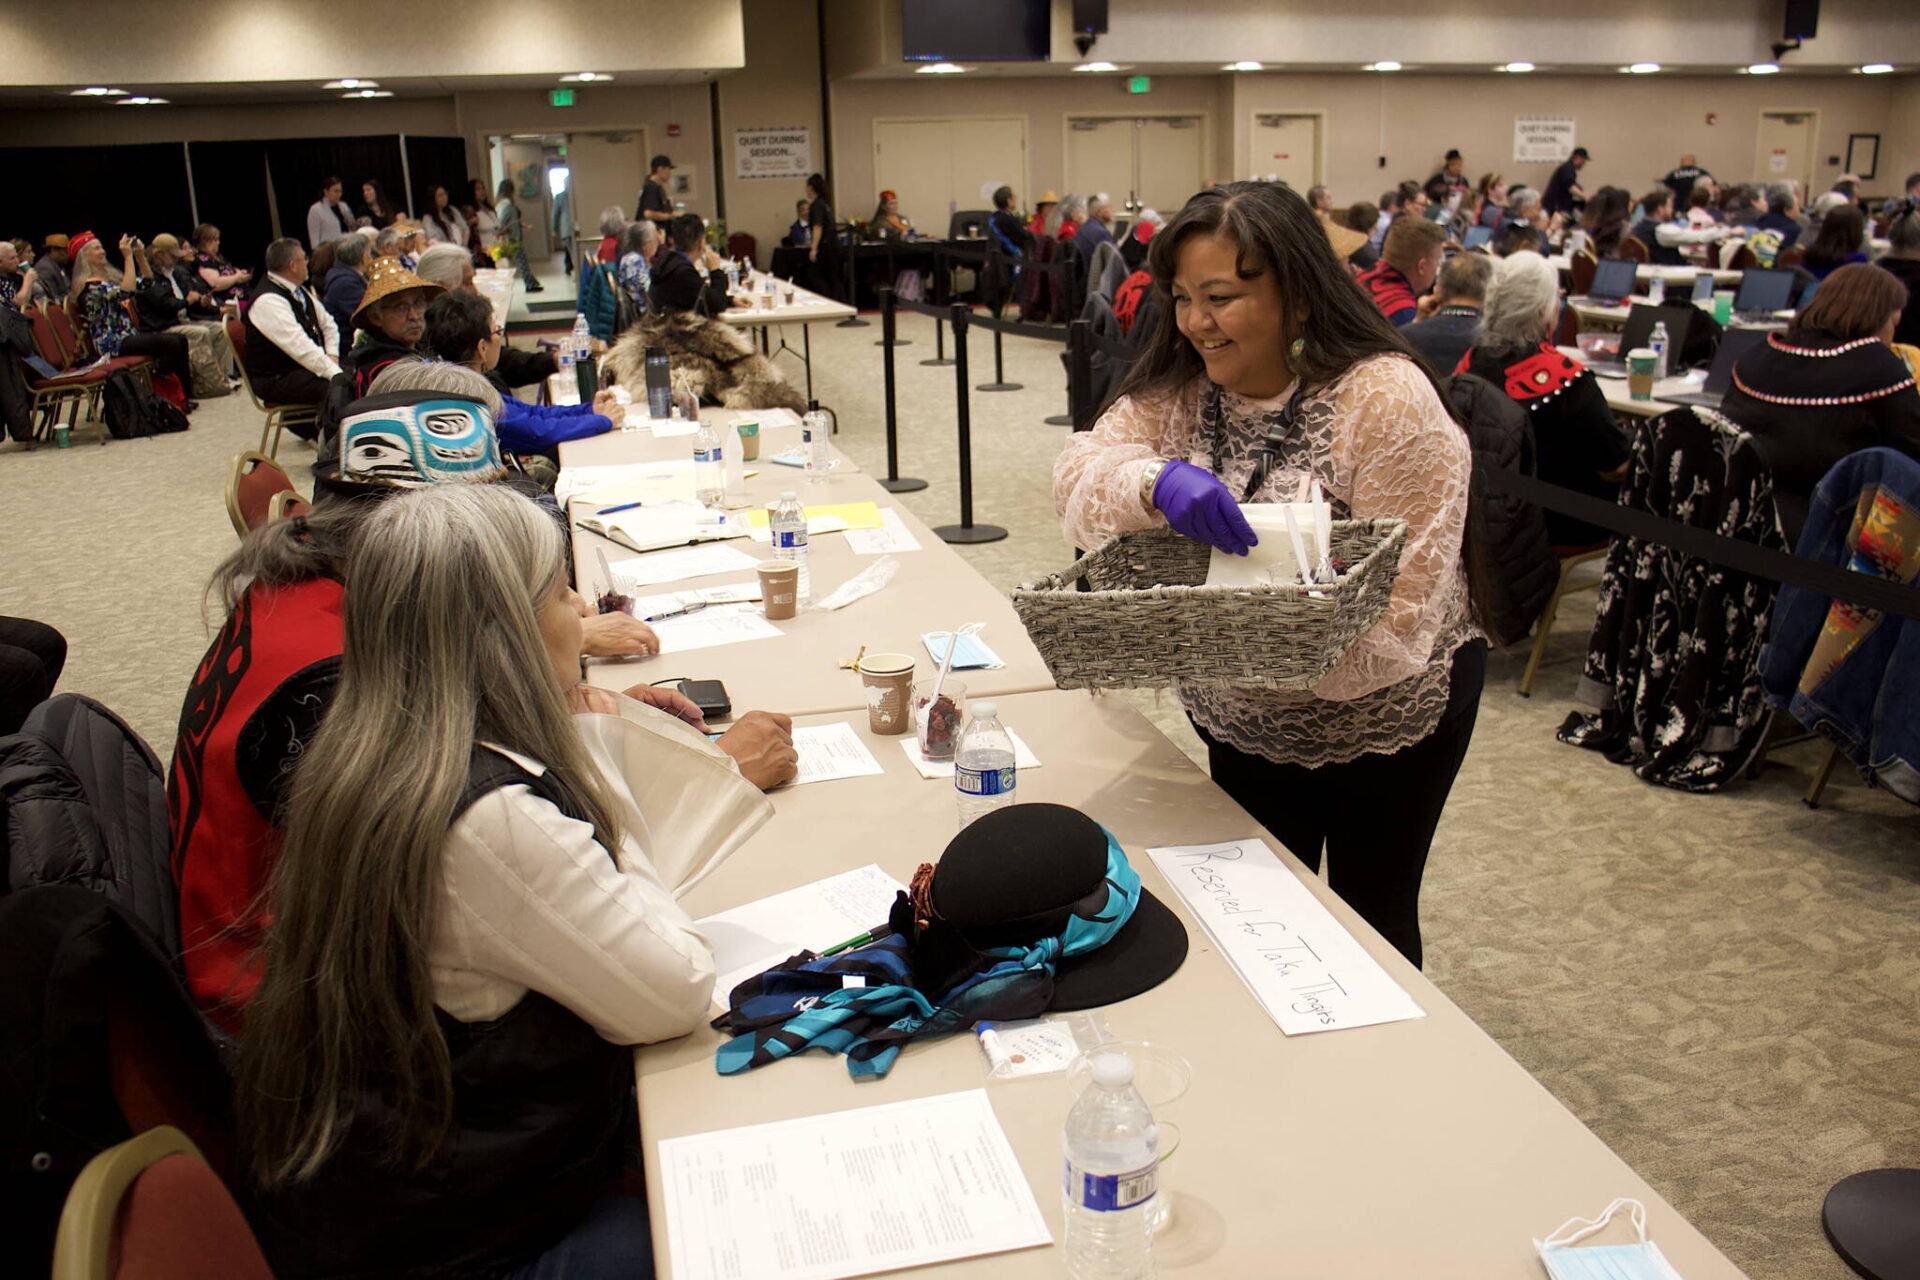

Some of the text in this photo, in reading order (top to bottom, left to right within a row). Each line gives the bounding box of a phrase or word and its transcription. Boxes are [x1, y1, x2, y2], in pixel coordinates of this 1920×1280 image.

[738, 135, 805, 146] QUIET DURING
[1176, 846, 1263, 916] Reserved
[1237, 921, 1286, 937] for
